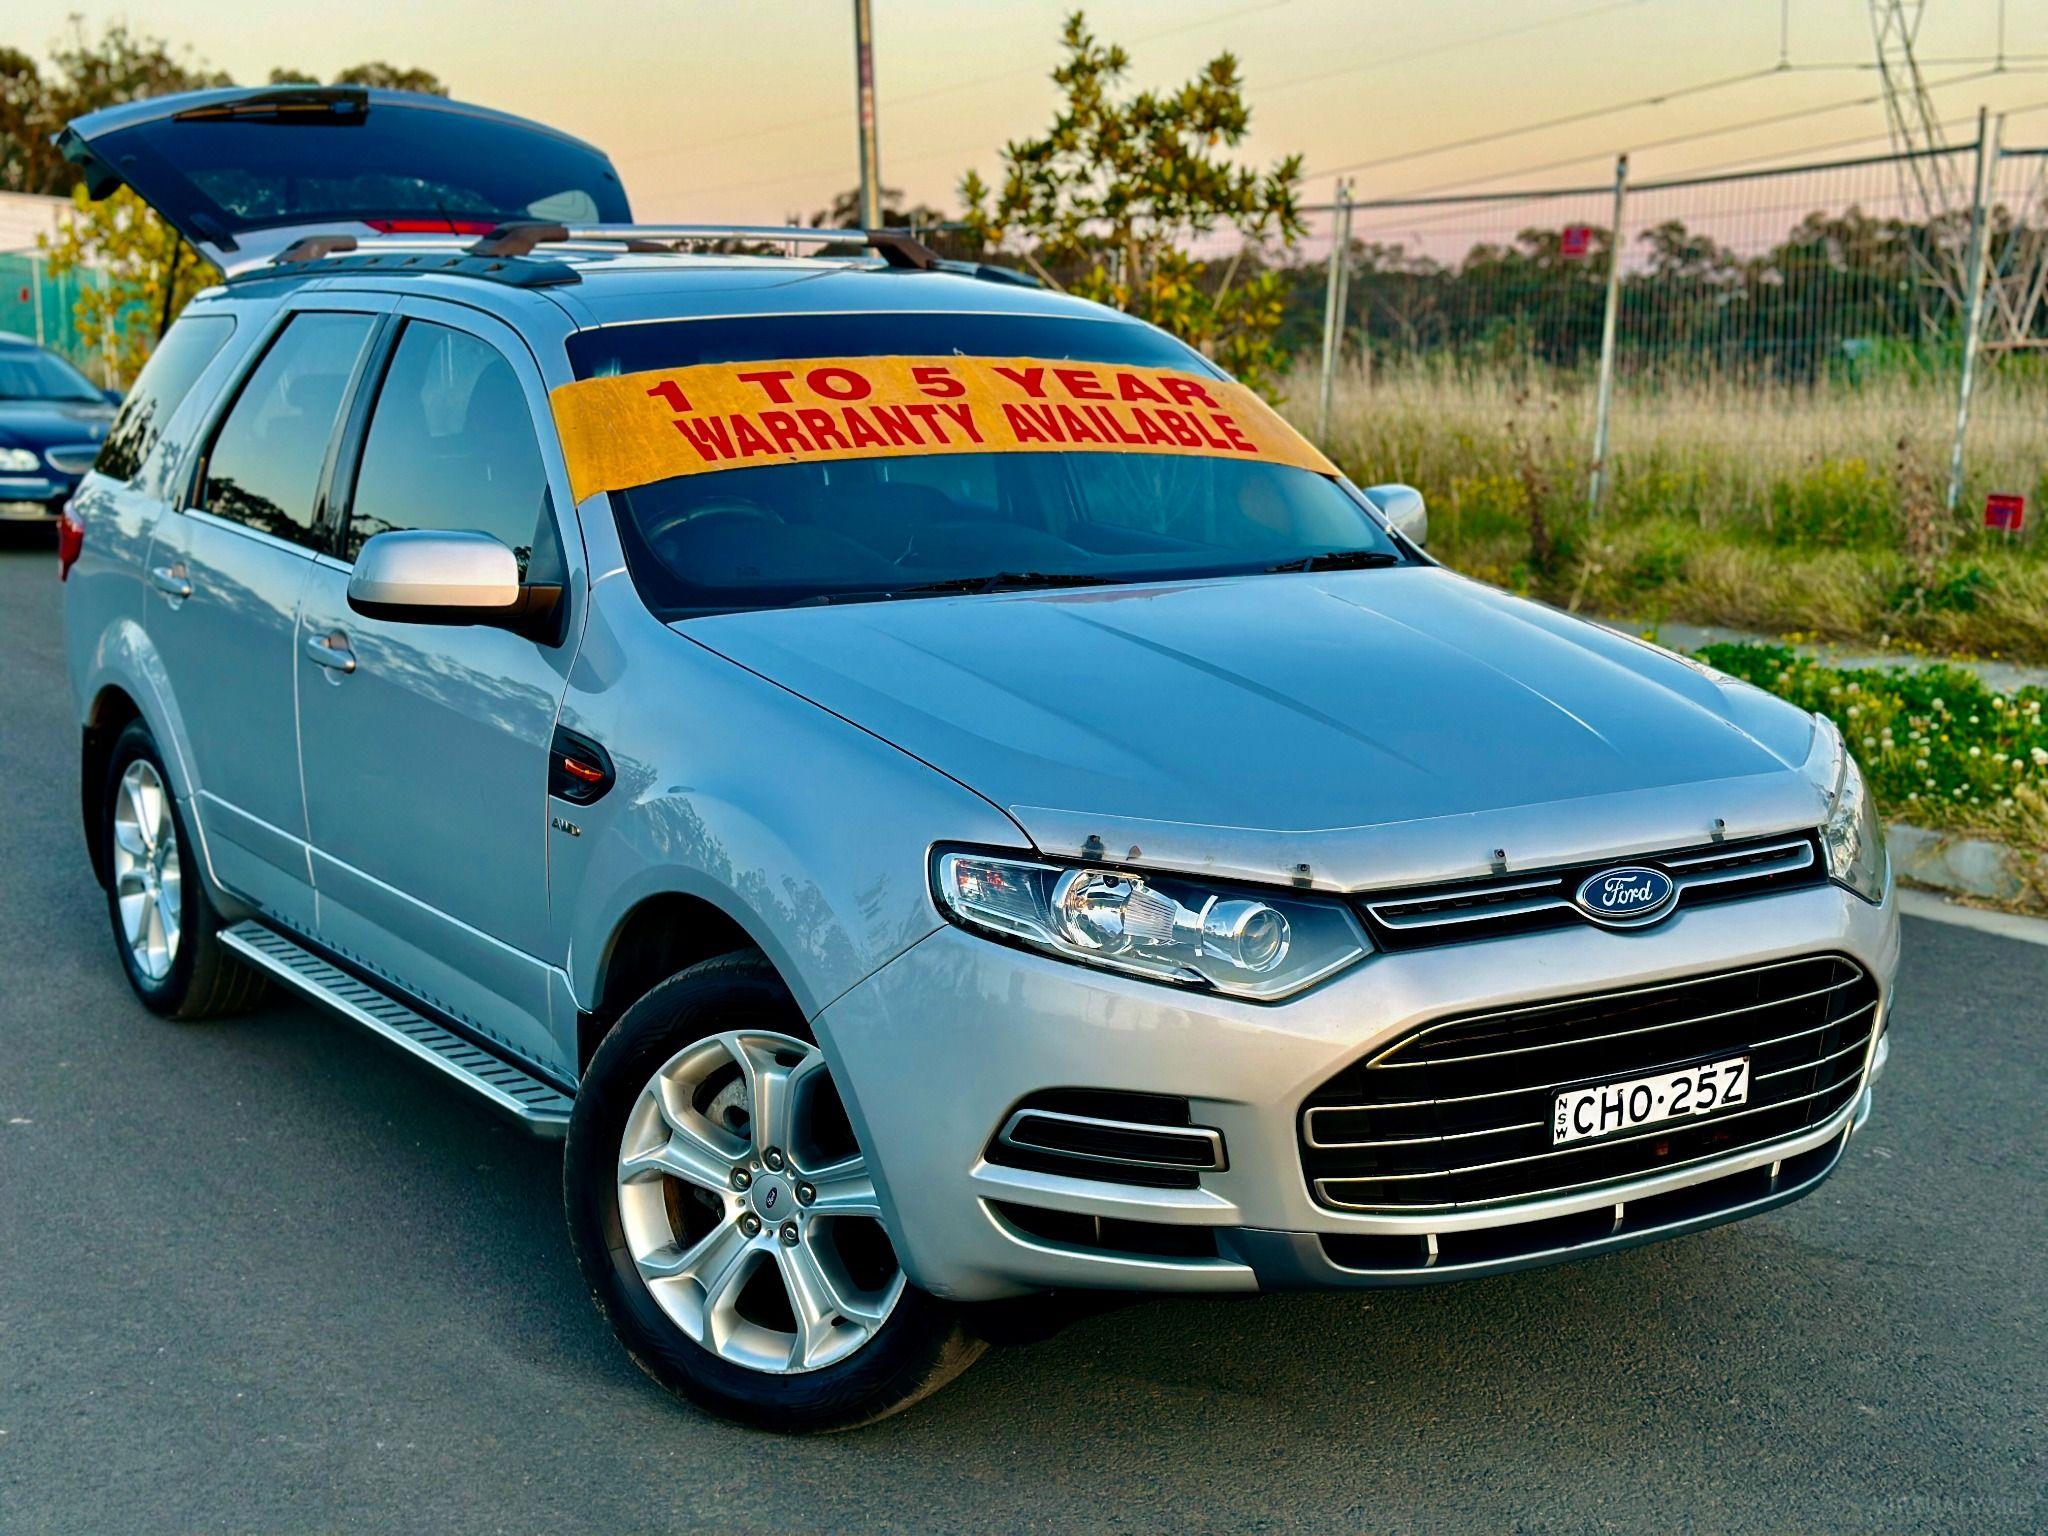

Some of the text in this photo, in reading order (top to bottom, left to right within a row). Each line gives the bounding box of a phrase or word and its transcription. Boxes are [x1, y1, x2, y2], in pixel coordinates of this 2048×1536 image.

[646, 367, 1221, 413] 1 TO 5 YEAR
[672, 403, 1259, 461] WARRANTY AVAILABLE
[1602, 875, 1653, 907] Ford
